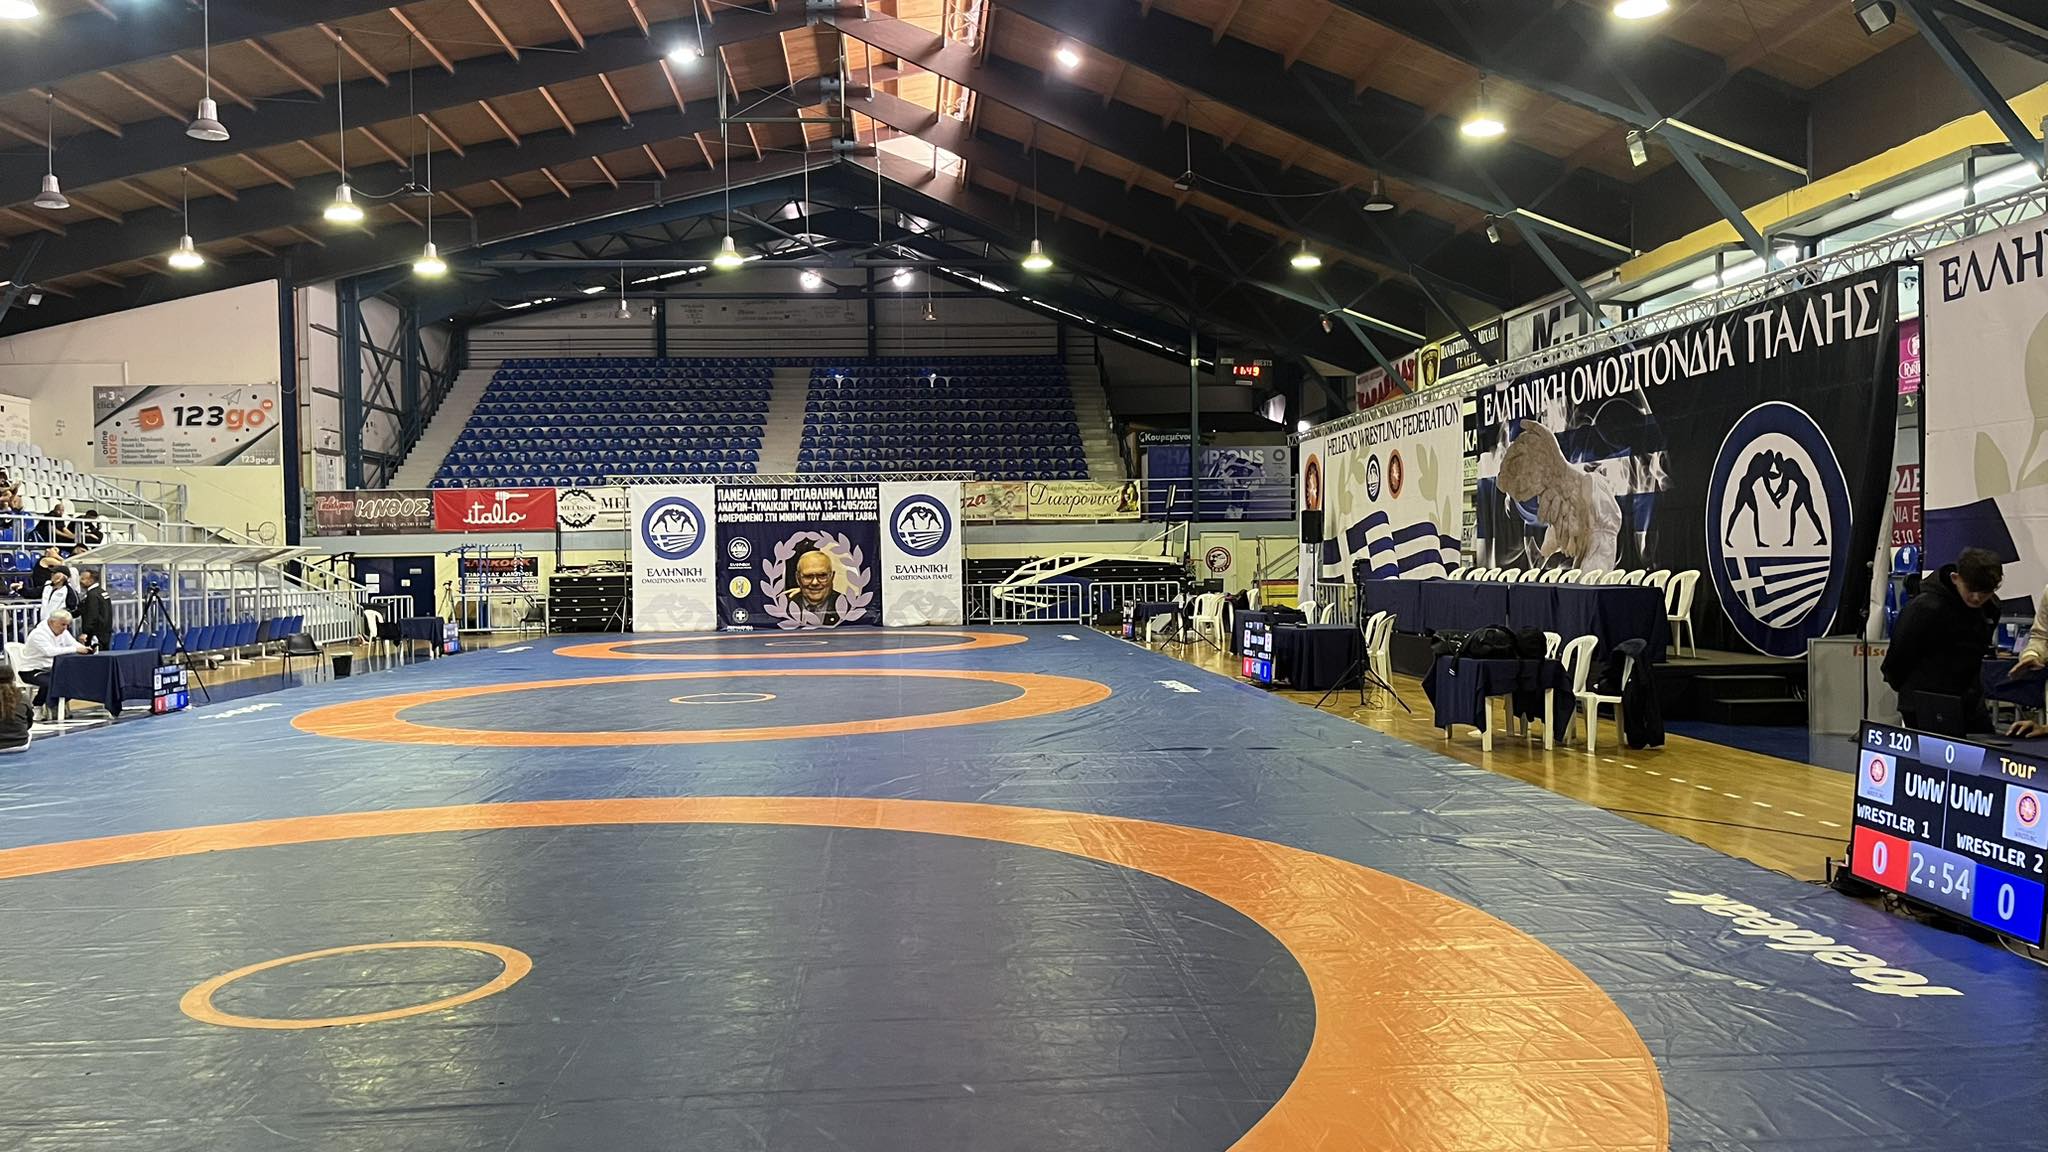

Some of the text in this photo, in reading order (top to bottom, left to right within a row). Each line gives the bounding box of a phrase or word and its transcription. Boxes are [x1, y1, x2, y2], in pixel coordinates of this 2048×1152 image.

[1939, 229, 2048, 302] ΕΛΛΗ
[1483, 372, 1566, 426] ΕΛΛΗΝΙΚΗ
[1570, 323, 1735, 405] ΟΜΟΣΠΟΝΔΙΑ
[1745, 280, 1880, 363] ΠΑΛΗΣ
[108, 391, 115, 400] 3
[173, 406, 266, 432] 123go
[1359, 418, 1401, 447] WRESTLING
[1402, 402, 1460, 437] FEDERATION
[107, 433, 117, 465] store
[241, 455, 275, 464] 123go.gr
[717, 487, 878, 501] ΠΑΝΕΛΛΗΝΙΟ ΠΡΩΤΑΘΛΗΜΑ ΠΑΛΗΣ
[717, 501, 877, 512] ΑΝΔΡΩΝ-ΓΥΝΑΙΚΩΝ ΤΡΙΚΑΛΑ 13-14/05/2023
[718, 512, 878, 523] ΑΦΙΕΡΩΜΕΝΟ ΣΤΗ ΜΝΗΜΗ ΤΟΥ ΔΗΜΗΤΡΗ ΣΑΒΒΑ
[646, 567, 703, 577] ΕΛΛΗΝΙΚΗ
[895, 563, 948, 573] ΕΛΛΗΝΙΚΗ
[1867, 729, 1912, 752] FS 120
[1945, 744, 1955, 764] 0
[1999, 757, 2037, 780] Tour
[1904, 771, 1946, 805] UWW
[1950, 783, 1994, 818] UWW
[1856, 803, 1931, 839] WRESTLER 1
[1871, 841, 1888, 875] 0
[1956, 832, 2026, 869] WRESTLER
[2033, 854, 2044, 874] 2
[1910, 852, 1971, 900] 2:54
[1997, 883, 2015, 921] 0
